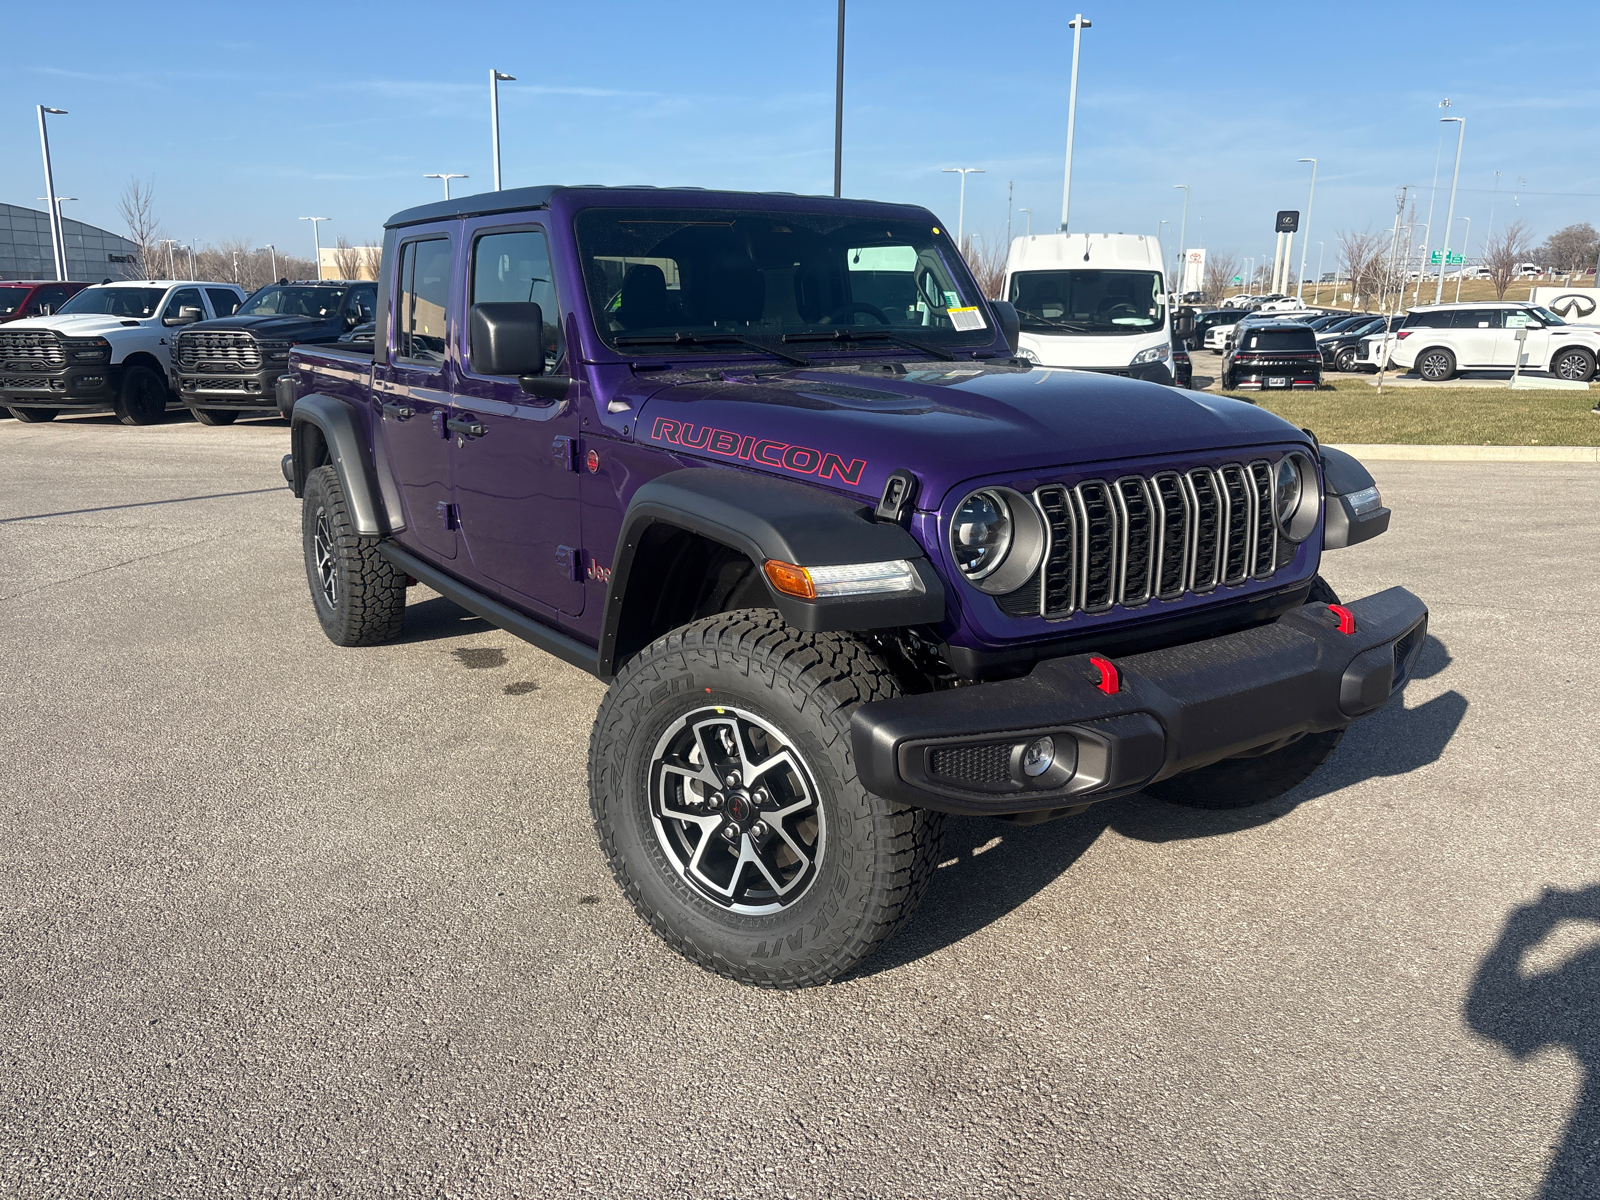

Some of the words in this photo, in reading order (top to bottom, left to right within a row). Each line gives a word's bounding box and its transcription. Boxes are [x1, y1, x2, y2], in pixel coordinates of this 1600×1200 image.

[2, 338, 40, 346] RAM
[195, 338, 234, 347] RAM
[651, 416, 867, 486] RUBICON
[587, 558, 612, 585] Jee
